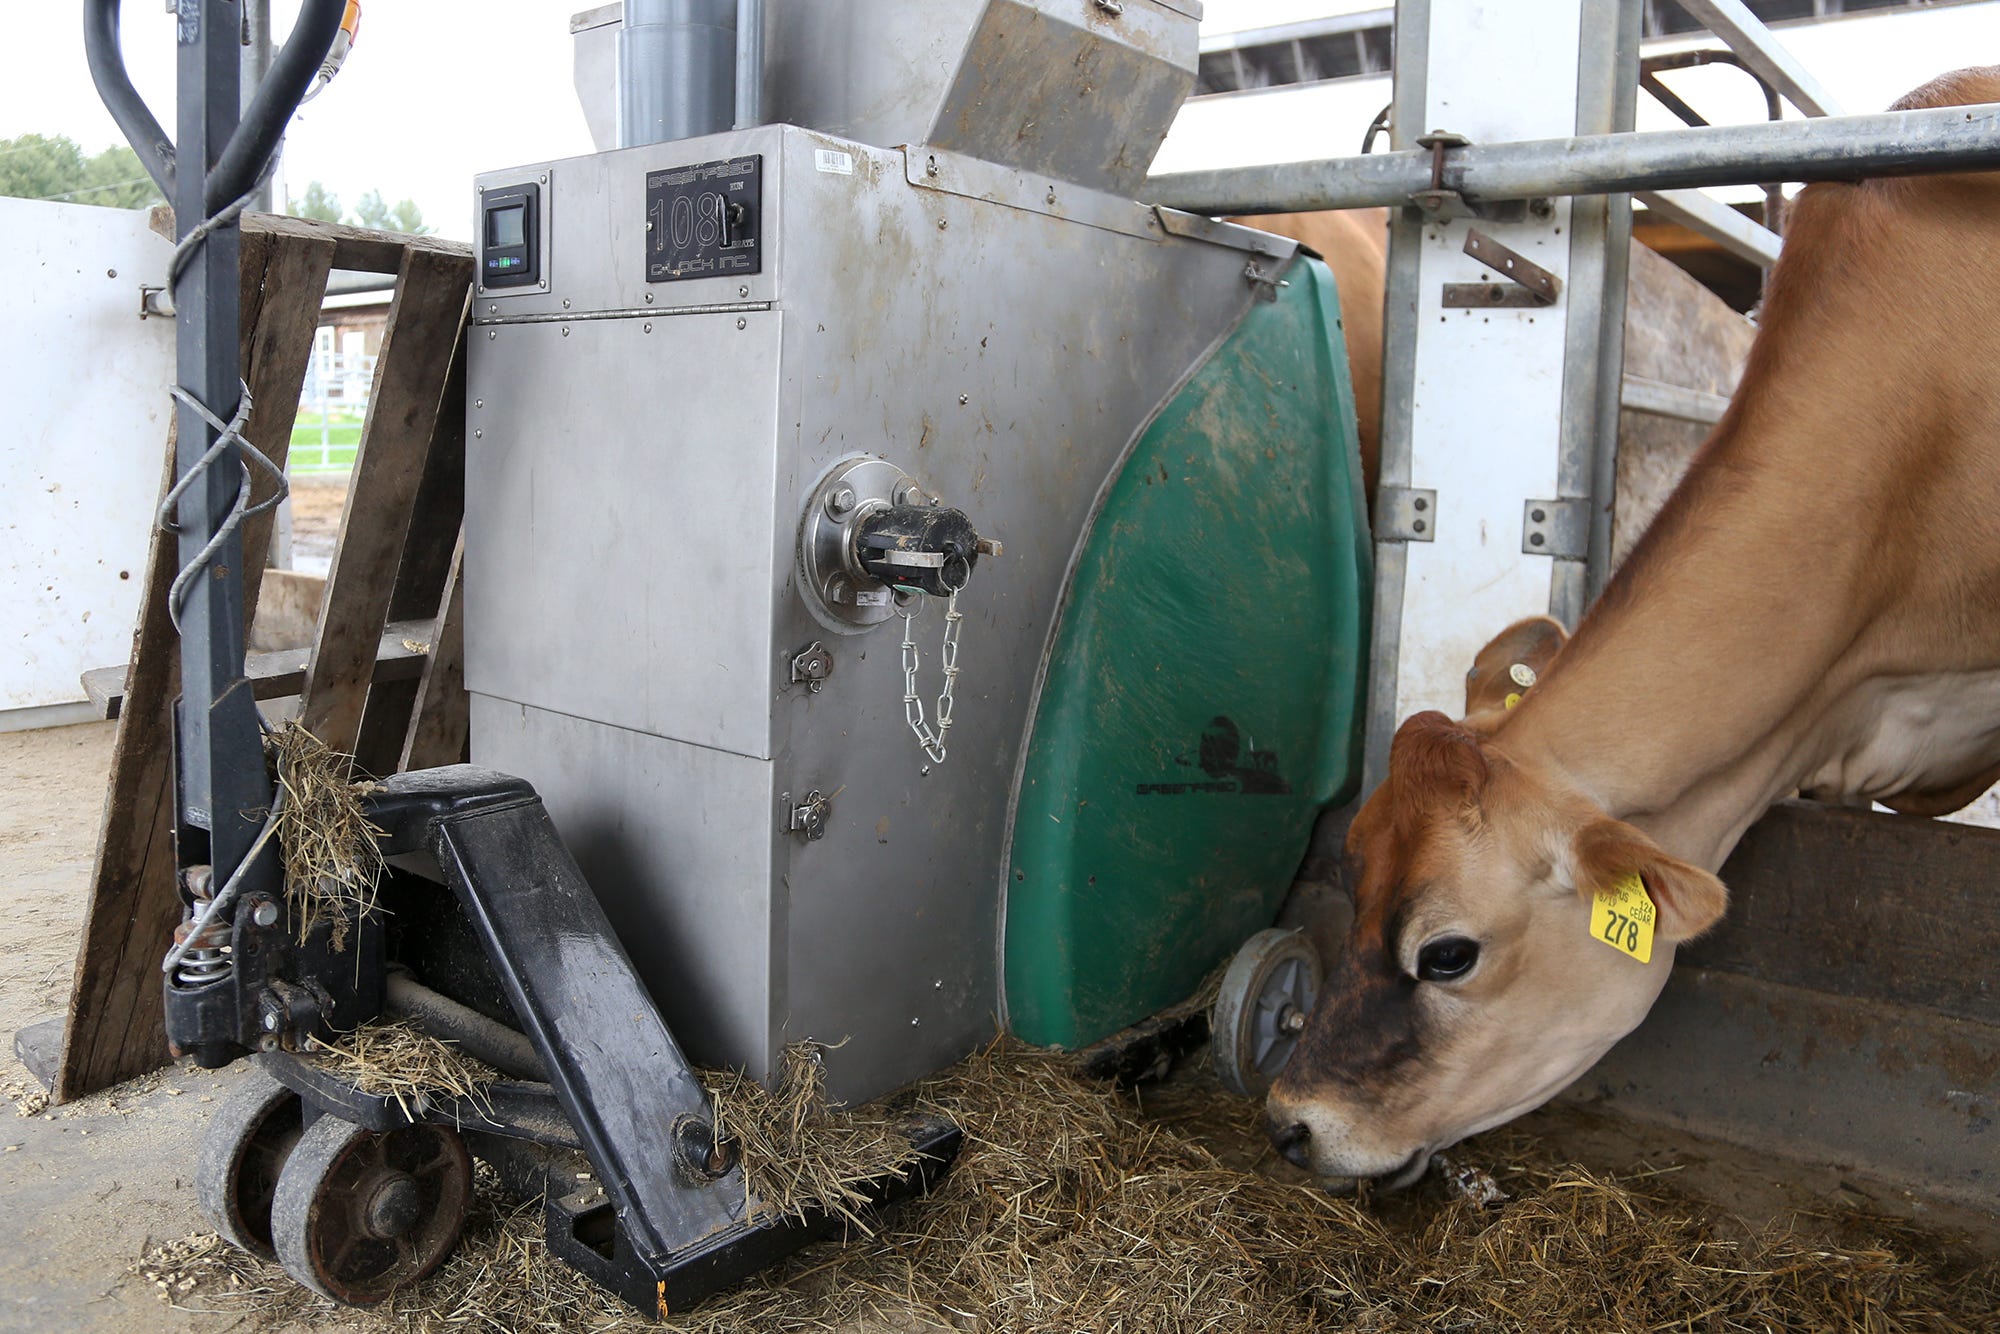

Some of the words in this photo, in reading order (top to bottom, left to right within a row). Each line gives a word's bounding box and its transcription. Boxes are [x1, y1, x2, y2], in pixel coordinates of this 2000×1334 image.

[729, 180, 745, 191] RUN
[649, 191, 720, 251] 108
[1604, 909, 1639, 953] 278
